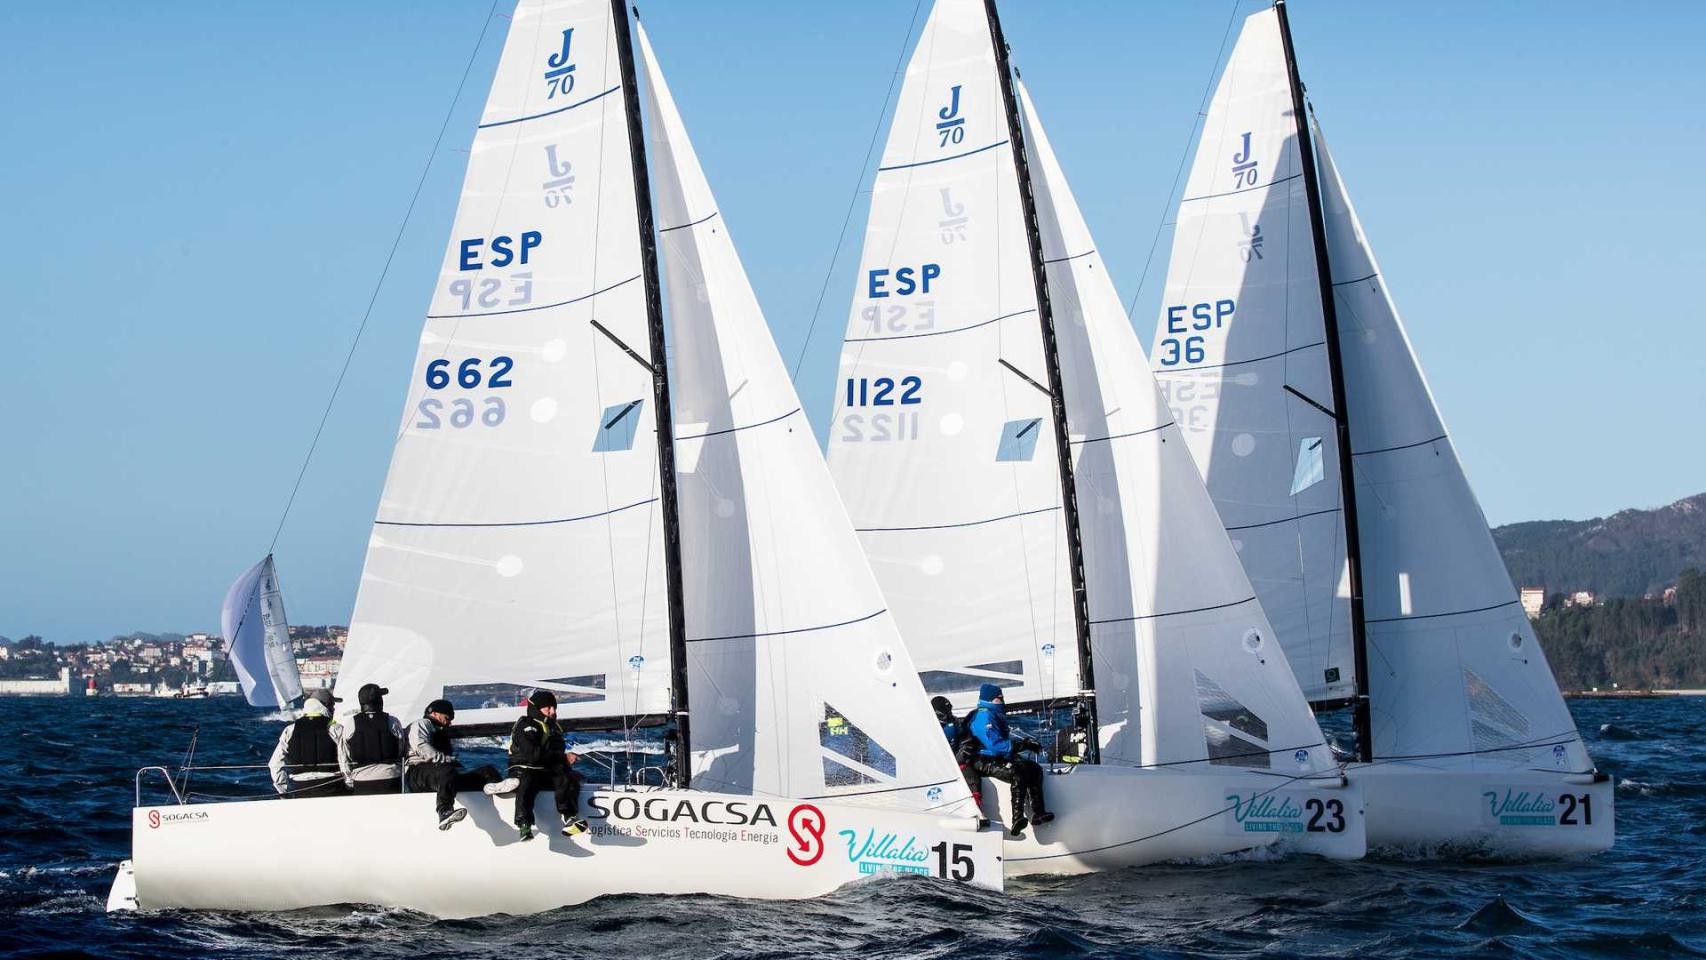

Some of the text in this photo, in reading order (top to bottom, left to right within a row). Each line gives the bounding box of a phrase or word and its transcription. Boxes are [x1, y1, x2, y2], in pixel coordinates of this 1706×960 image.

[547, 28, 574, 68] J
[546, 74, 574, 100] 70
[938, 85, 962, 120] J
[939, 127, 964, 148] 70
[1233, 132, 1252, 164] J
[1234, 168, 1258, 189] 70
[459, 231, 542, 272] ESP
[869, 263, 941, 299] ESP
[1167, 299, 1235, 334] ESP
[1160, 336, 1205, 366] 36
[425, 356, 514, 390] 662
[846, 375, 922, 407] 1122
[162, 811, 209, 822] SOGACSA
[587, 796, 777, 827] SOGACSA
[1226, 792, 1346, 833] Villalia 23
[1483, 788, 1592, 825] Villalia 21
[635, 825, 681, 839] Servicios
[838, 827, 975, 882] Villalia 15
